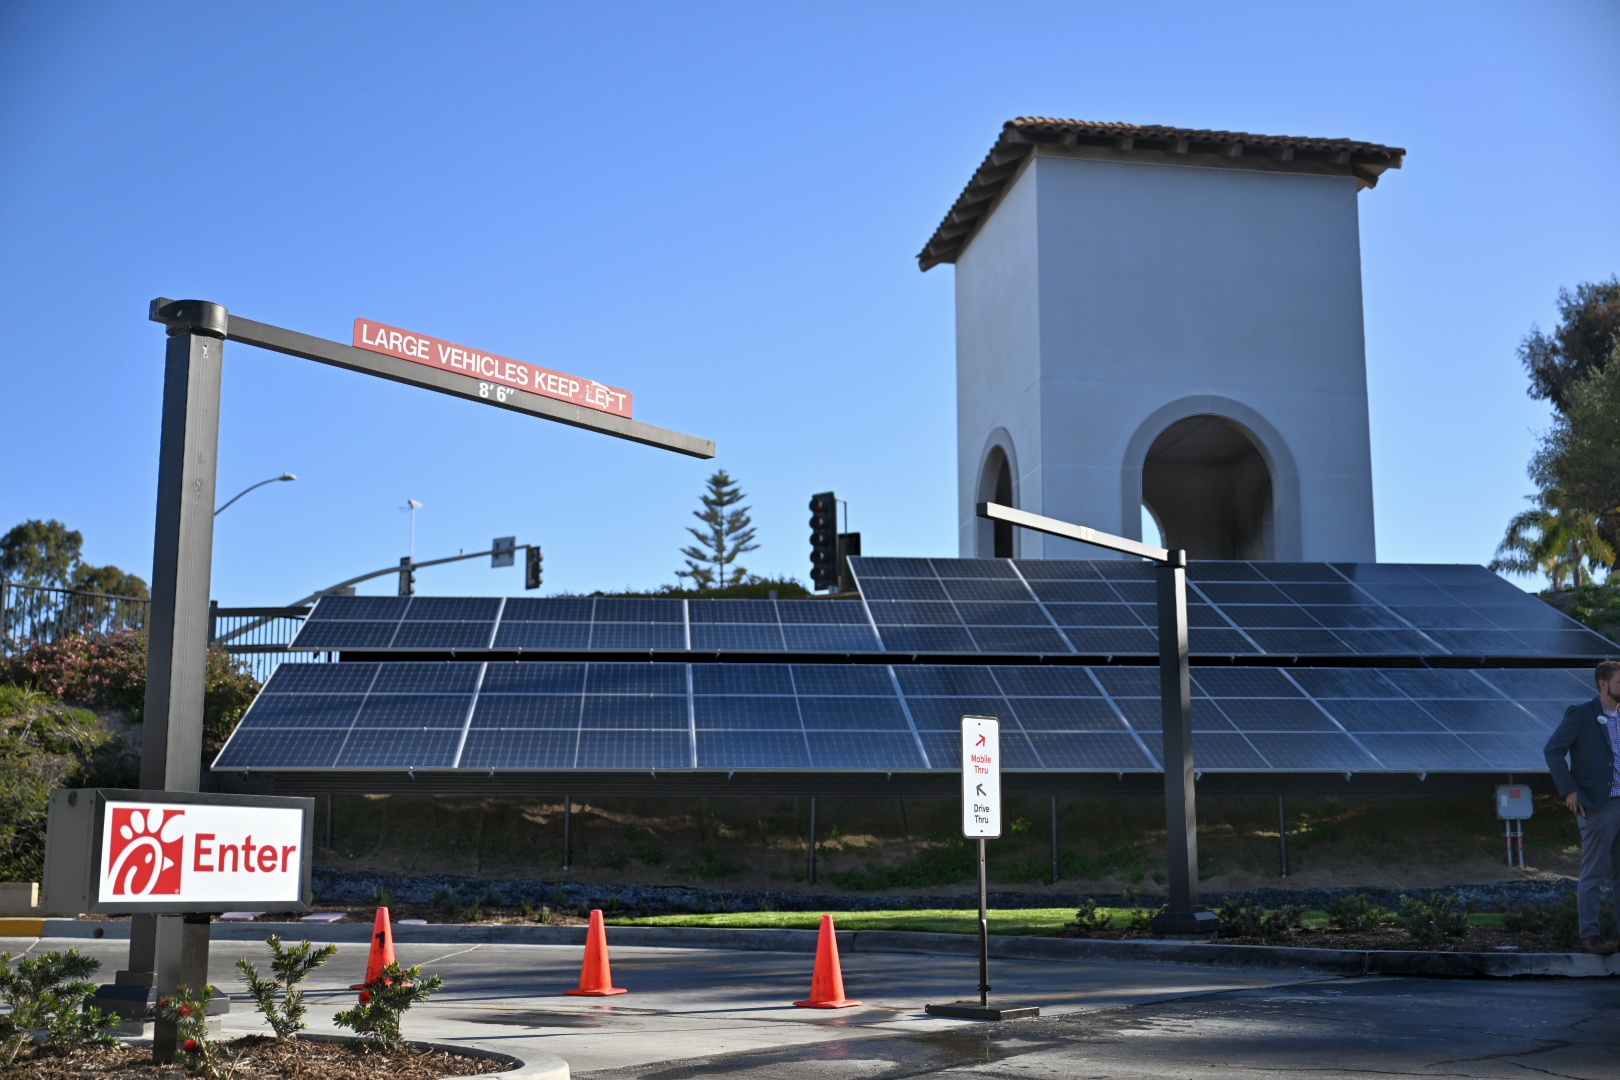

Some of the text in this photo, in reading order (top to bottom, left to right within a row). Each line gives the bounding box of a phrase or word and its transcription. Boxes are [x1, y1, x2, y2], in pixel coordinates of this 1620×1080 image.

[362, 324, 627, 411] LARGE VEHICLES KEEP LEFT
[971, 754, 992, 764] Mobile
[974, 765, 989, 774] Thru
[973, 804, 990, 813] Drive
[974, 815, 989, 824] Thru
[193, 833, 297, 873] Enter
